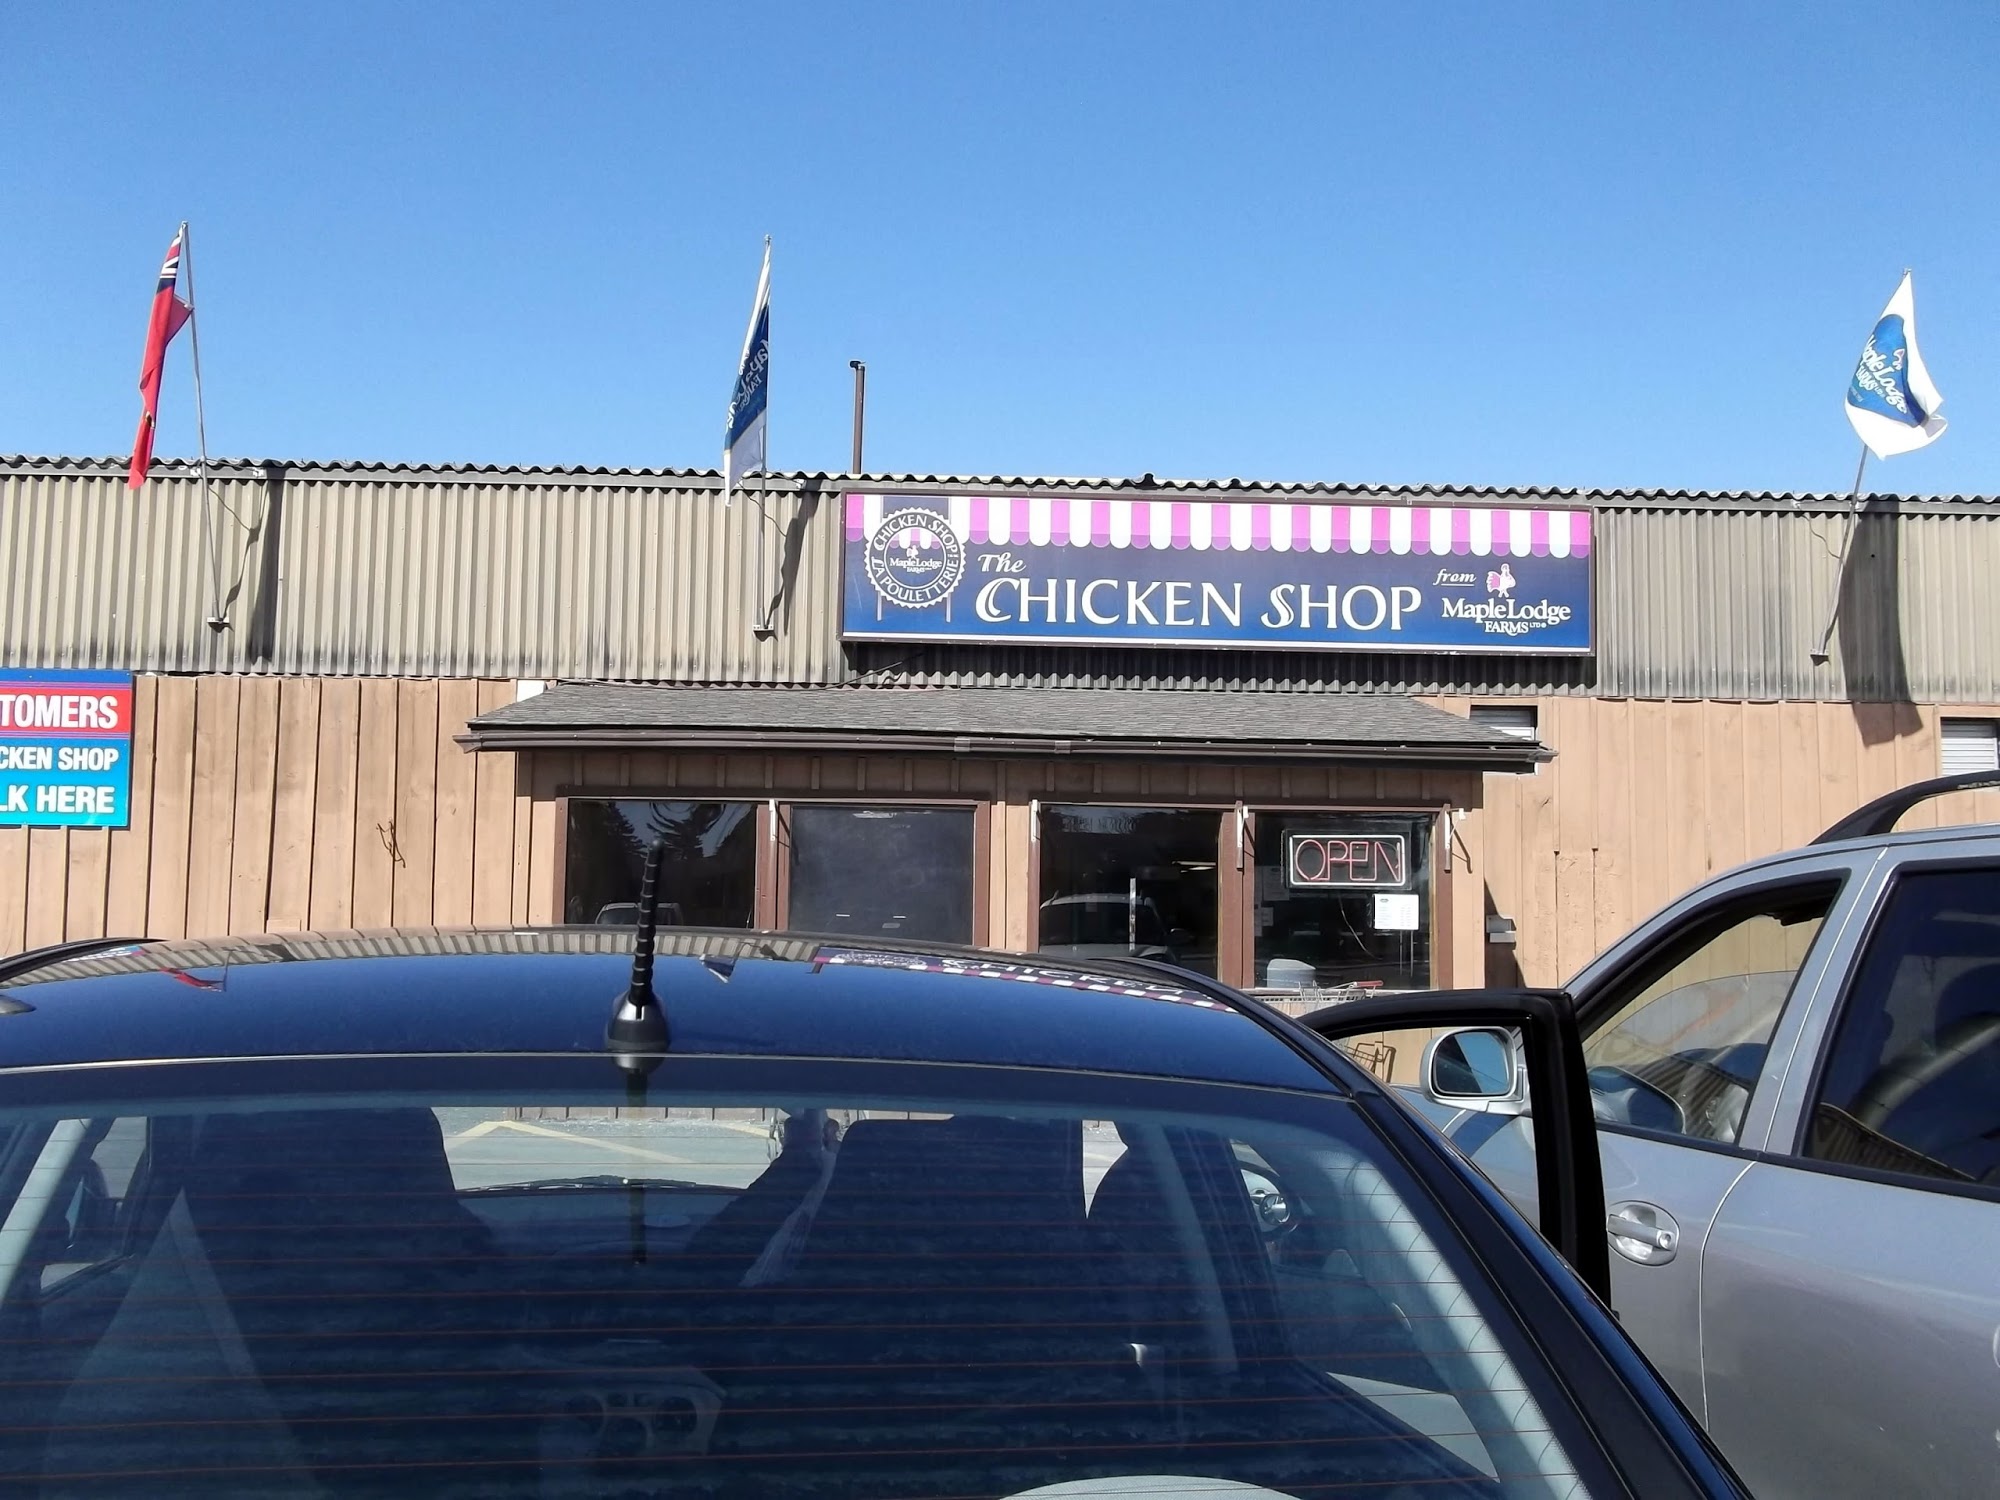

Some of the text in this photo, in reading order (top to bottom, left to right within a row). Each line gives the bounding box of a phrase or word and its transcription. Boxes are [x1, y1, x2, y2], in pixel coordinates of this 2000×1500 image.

[873, 514, 958, 553] CHICKEN SHOP
[871, 556, 885, 578] LA
[977, 551, 1027, 573] The
[1432, 568, 1477, 586] from
[975, 577, 1422, 631] CHICKEN SHOP
[1484, 620, 1530, 637] FARMS
[57, 747, 120, 771] SHOP
[0, 784, 115, 814] K HERE
[1295, 839, 1401, 882] OPEN
